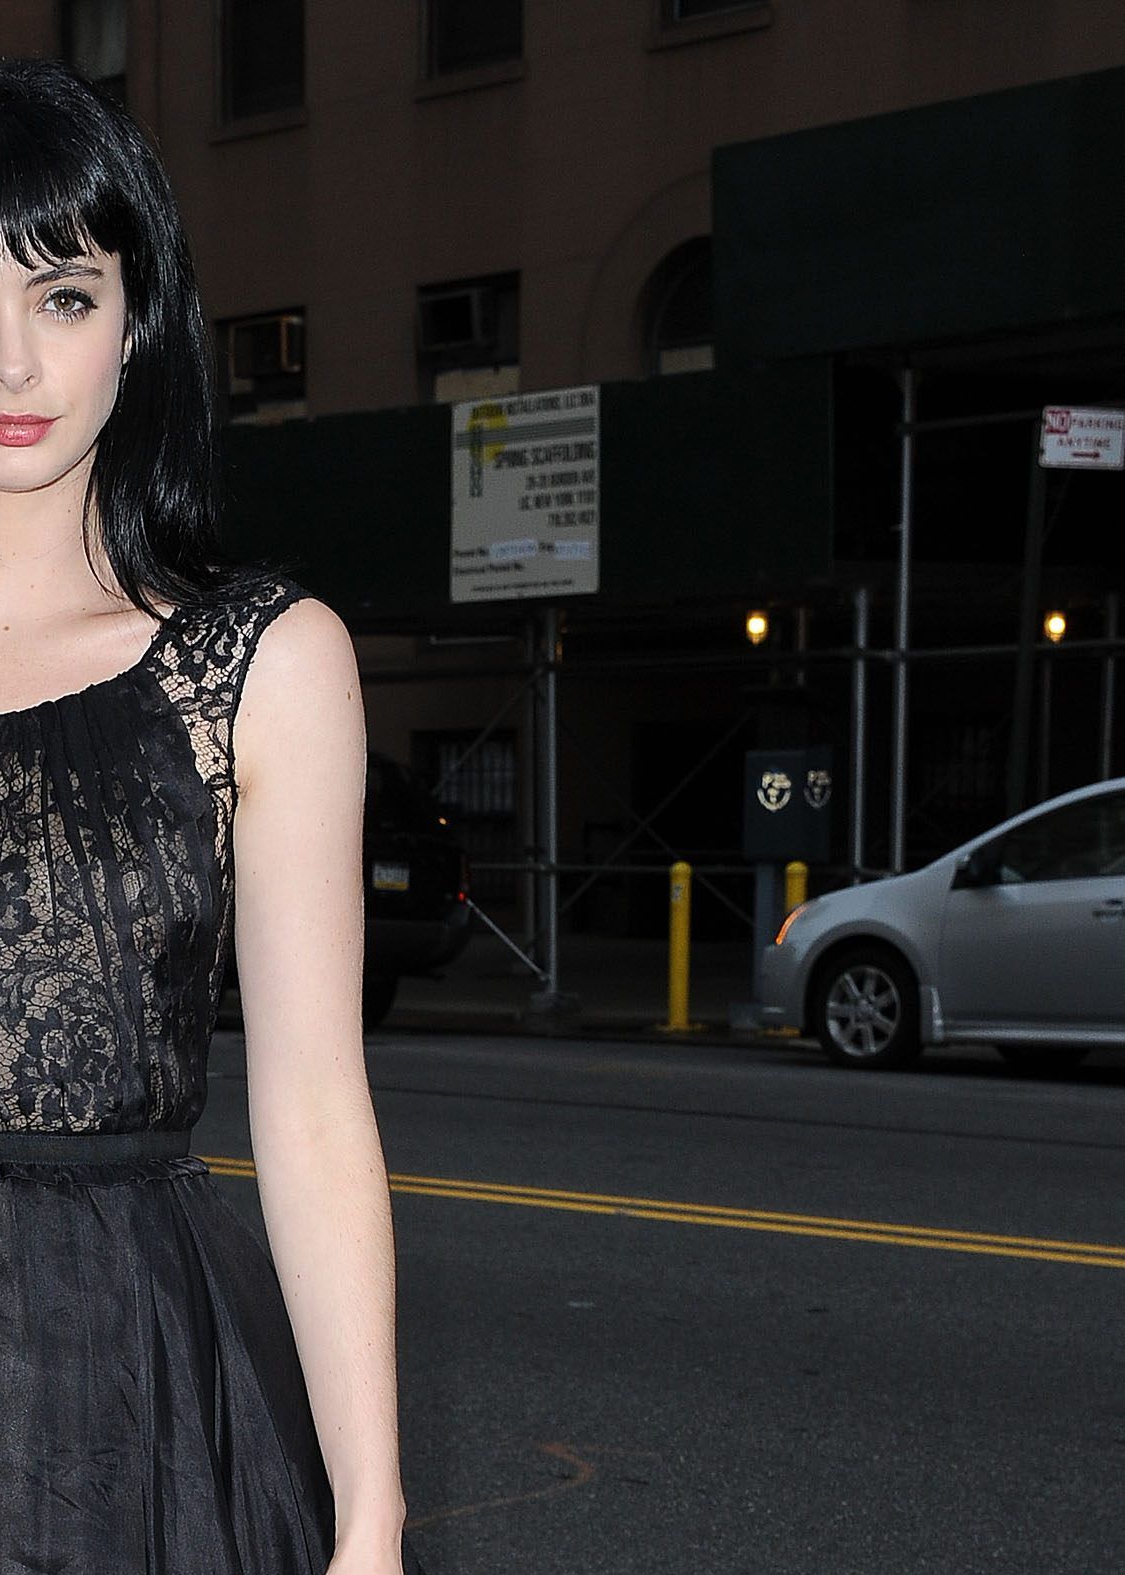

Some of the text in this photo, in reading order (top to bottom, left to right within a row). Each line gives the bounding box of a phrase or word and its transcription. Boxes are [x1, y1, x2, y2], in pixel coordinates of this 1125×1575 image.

[1046, 411, 1123, 431] NO PARKING
[1056, 436, 1112, 449] ANYTIME
